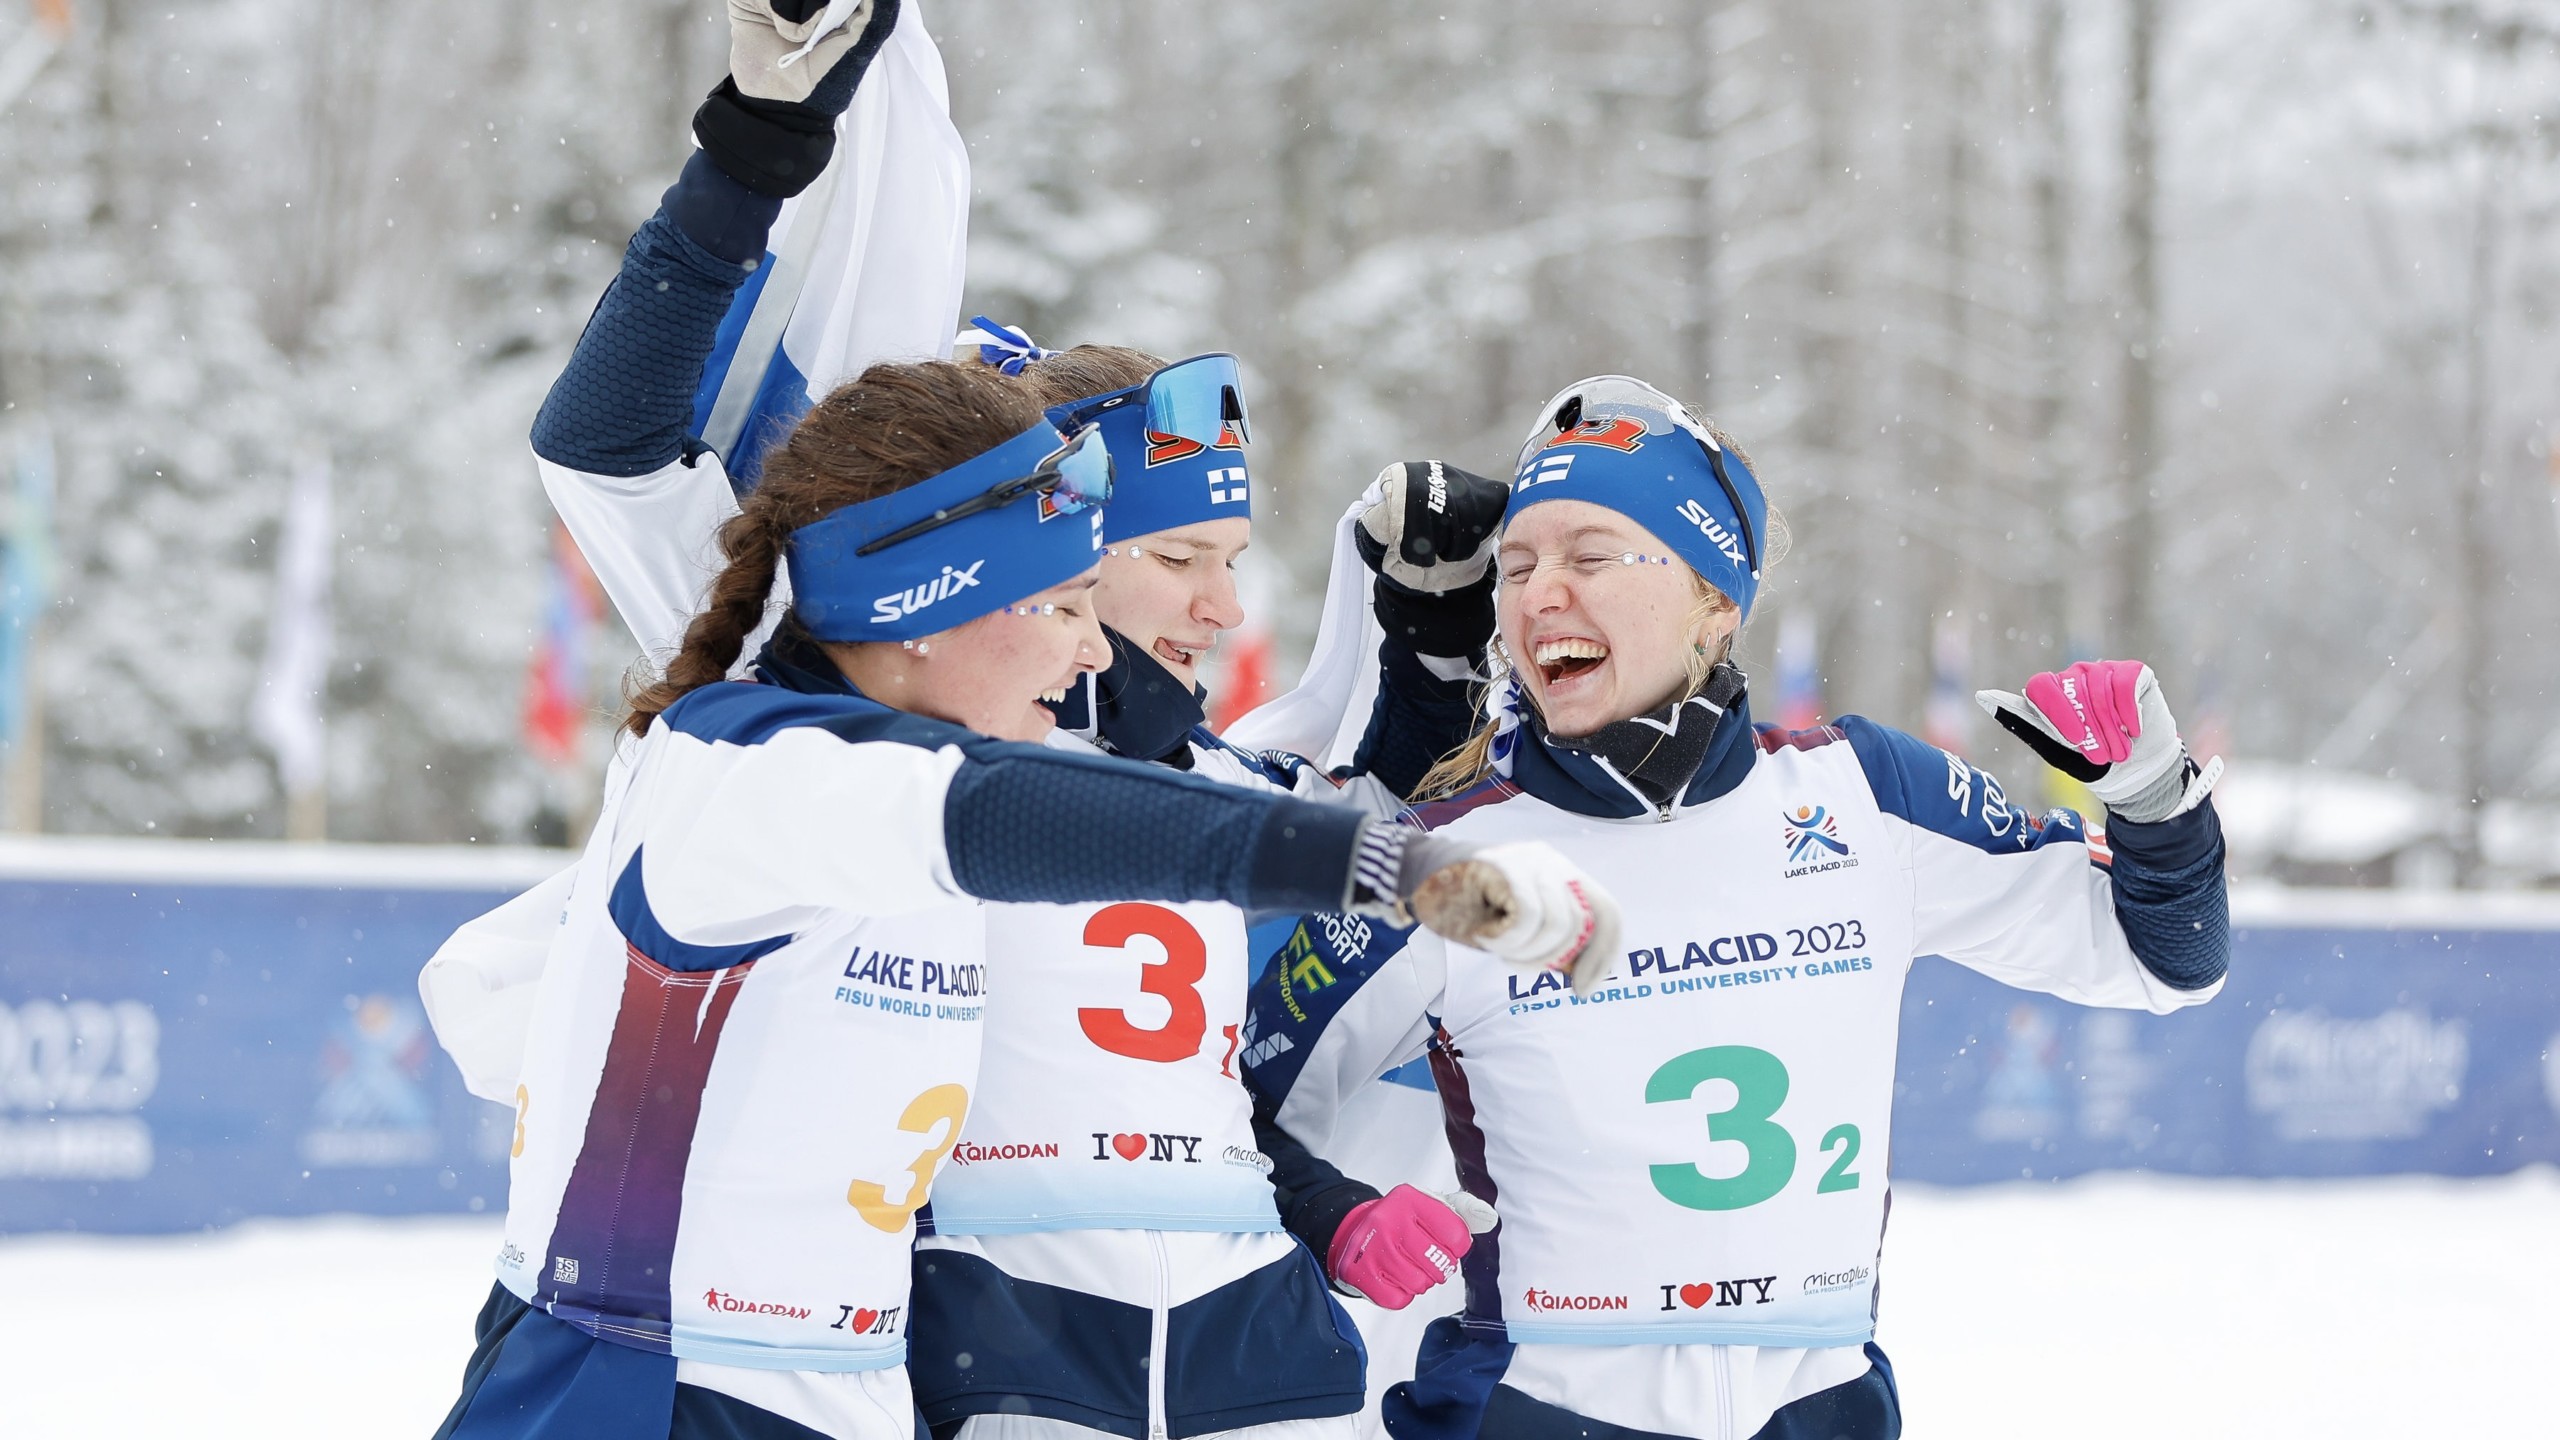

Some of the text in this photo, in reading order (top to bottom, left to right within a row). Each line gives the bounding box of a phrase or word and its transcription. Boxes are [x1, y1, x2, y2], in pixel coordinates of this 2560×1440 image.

[1784, 858, 1859, 879] LAKE PLACID 2023
[1314, 911, 1363, 965] PORT
[1628, 932, 1778, 977] PLACID
[1785, 919, 1867, 957] 2023
[844, 946, 914, 990] LAKE
[921, 960, 979, 998] PLACID
[1078, 902, 1206, 1063] 3
[1568, 984, 1653, 1006] WORLD
[1661, 966, 1798, 995] UNIVERSITY
[1804, 956, 1873, 979] GAMES
[835, 986, 874, 1008] FISU
[879, 995, 931, 1019] WORLD
[0, 999, 160, 1112] 023
[1092, 1133, 1110, 1160] I
[1644, 1044, 1862, 1212] 3 2
[846, 1083, 969, 1234] 3
[966, 1143, 1059, 1162] QIAODAN
[723, 1298, 812, 1320] QIAODAN
[830, 1304, 854, 1330] I
[1541, 1295, 1628, 1311] QIAODAN
[1660, 1284, 1678, 1311] I
